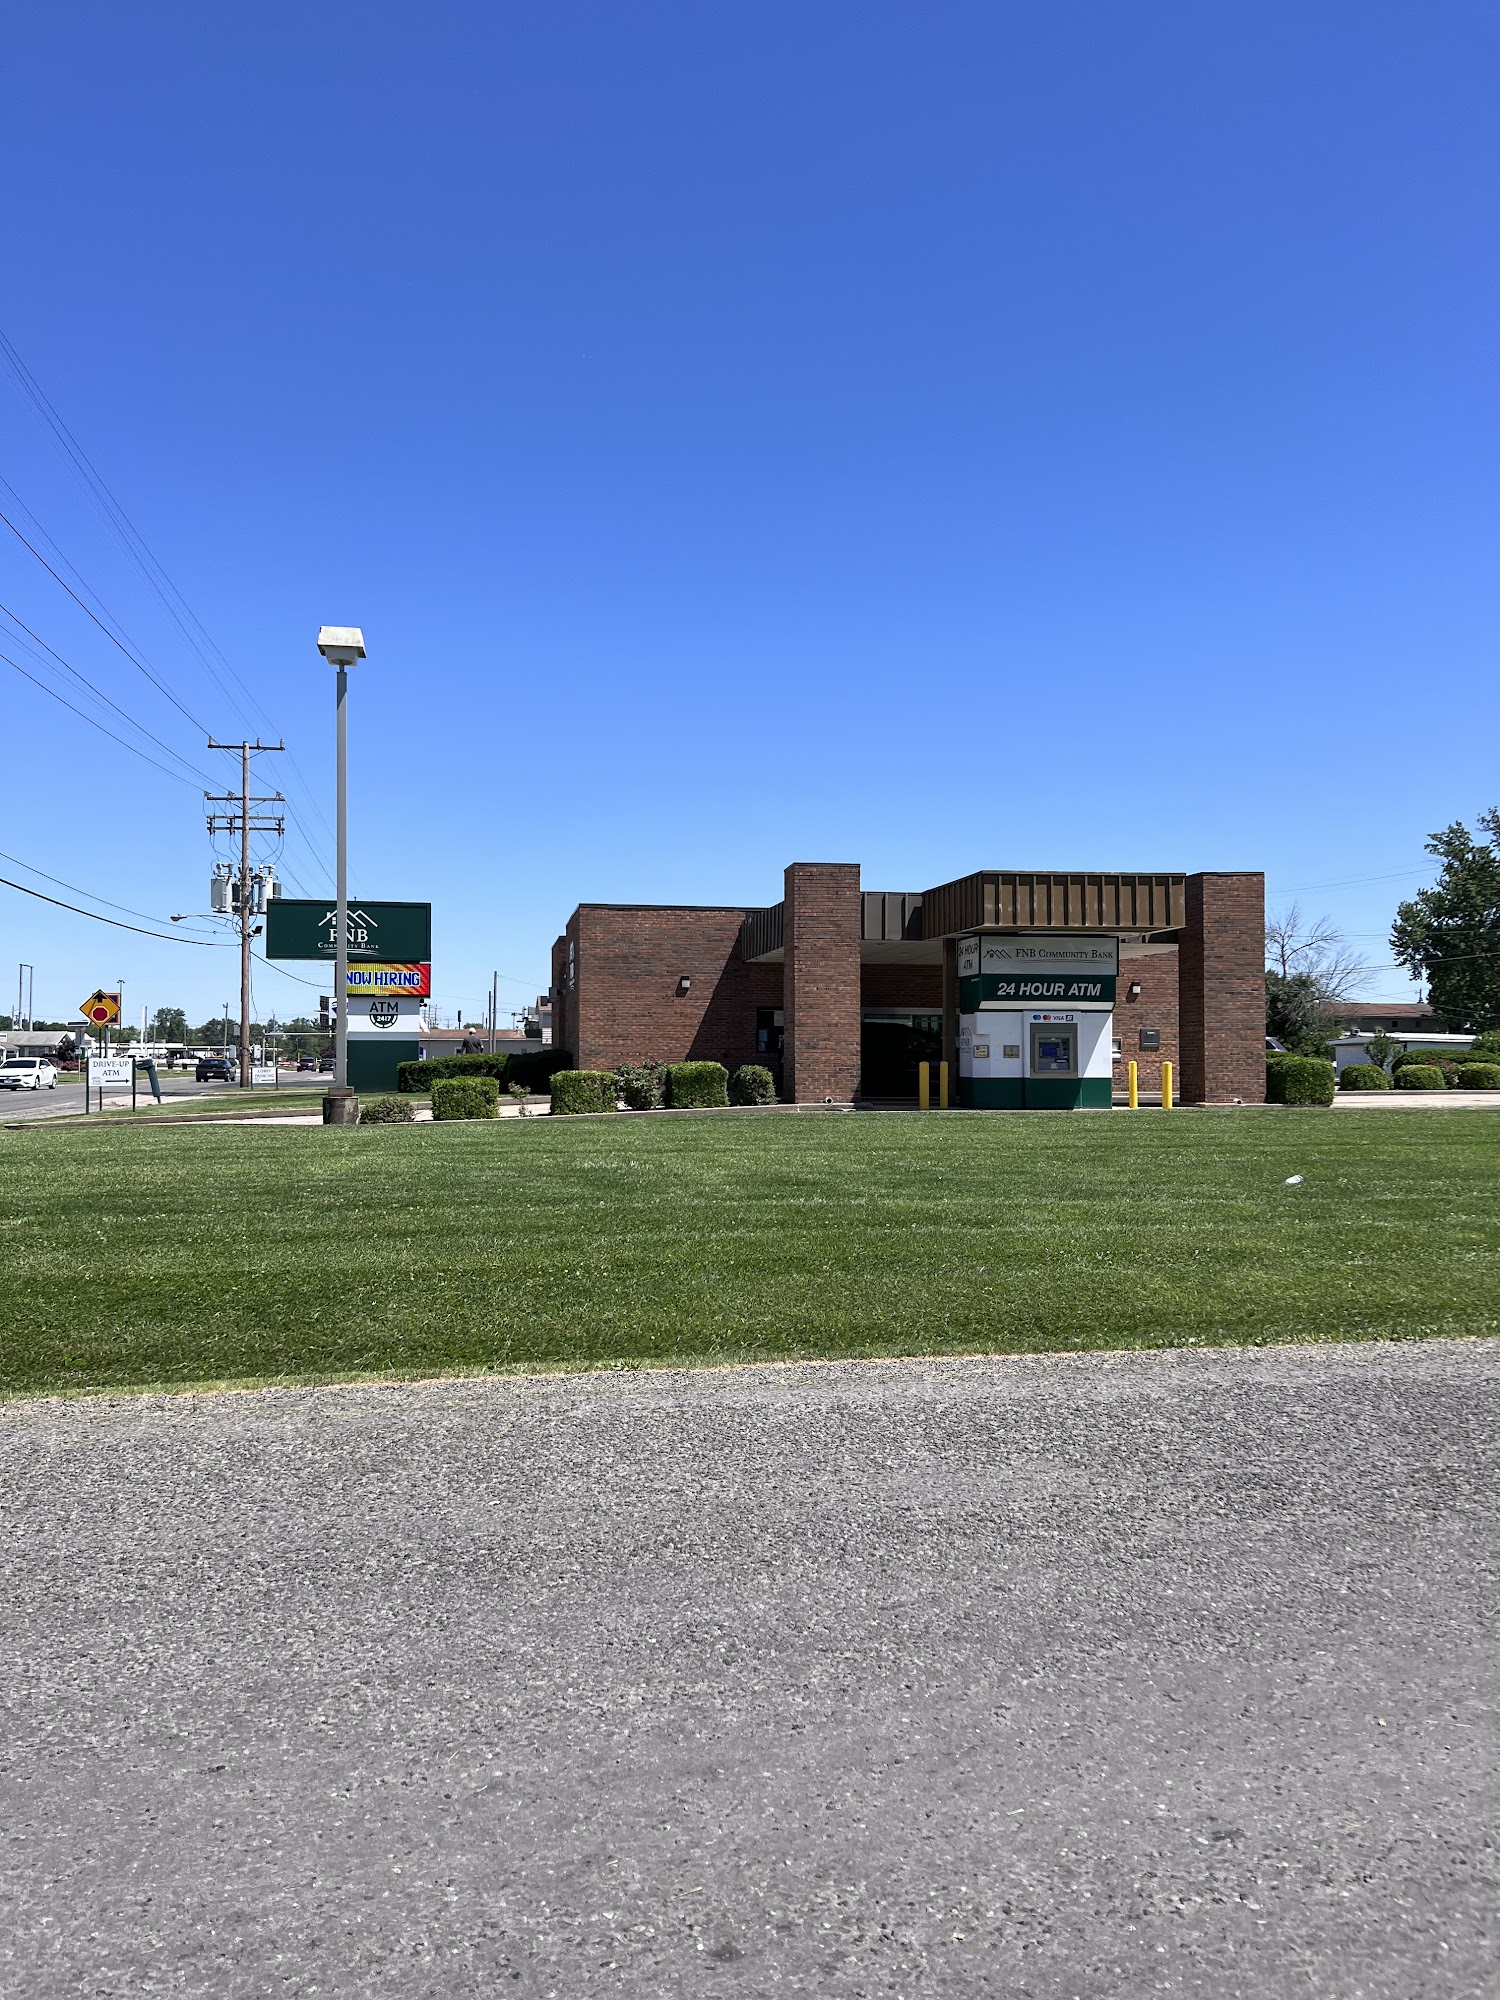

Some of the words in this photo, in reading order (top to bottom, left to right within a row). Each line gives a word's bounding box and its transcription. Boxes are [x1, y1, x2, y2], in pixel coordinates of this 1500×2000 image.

[329, 928, 368, 942] FNB
[1015, 949, 1036, 958] FNB
[963, 959, 973, 970] ATM
[346, 971, 372, 985] NOW
[374, 971, 420, 986] HIRING
[997, 982, 1016, 996] 24
[1018, 982, 1065, 996] HOUR
[1067, 983, 1102, 997] ATM
[369, 1001, 399, 1013] ATM
[93, 1060, 130, 1068] DRIVE-UP
[102, 1069, 120, 1077] ATM
